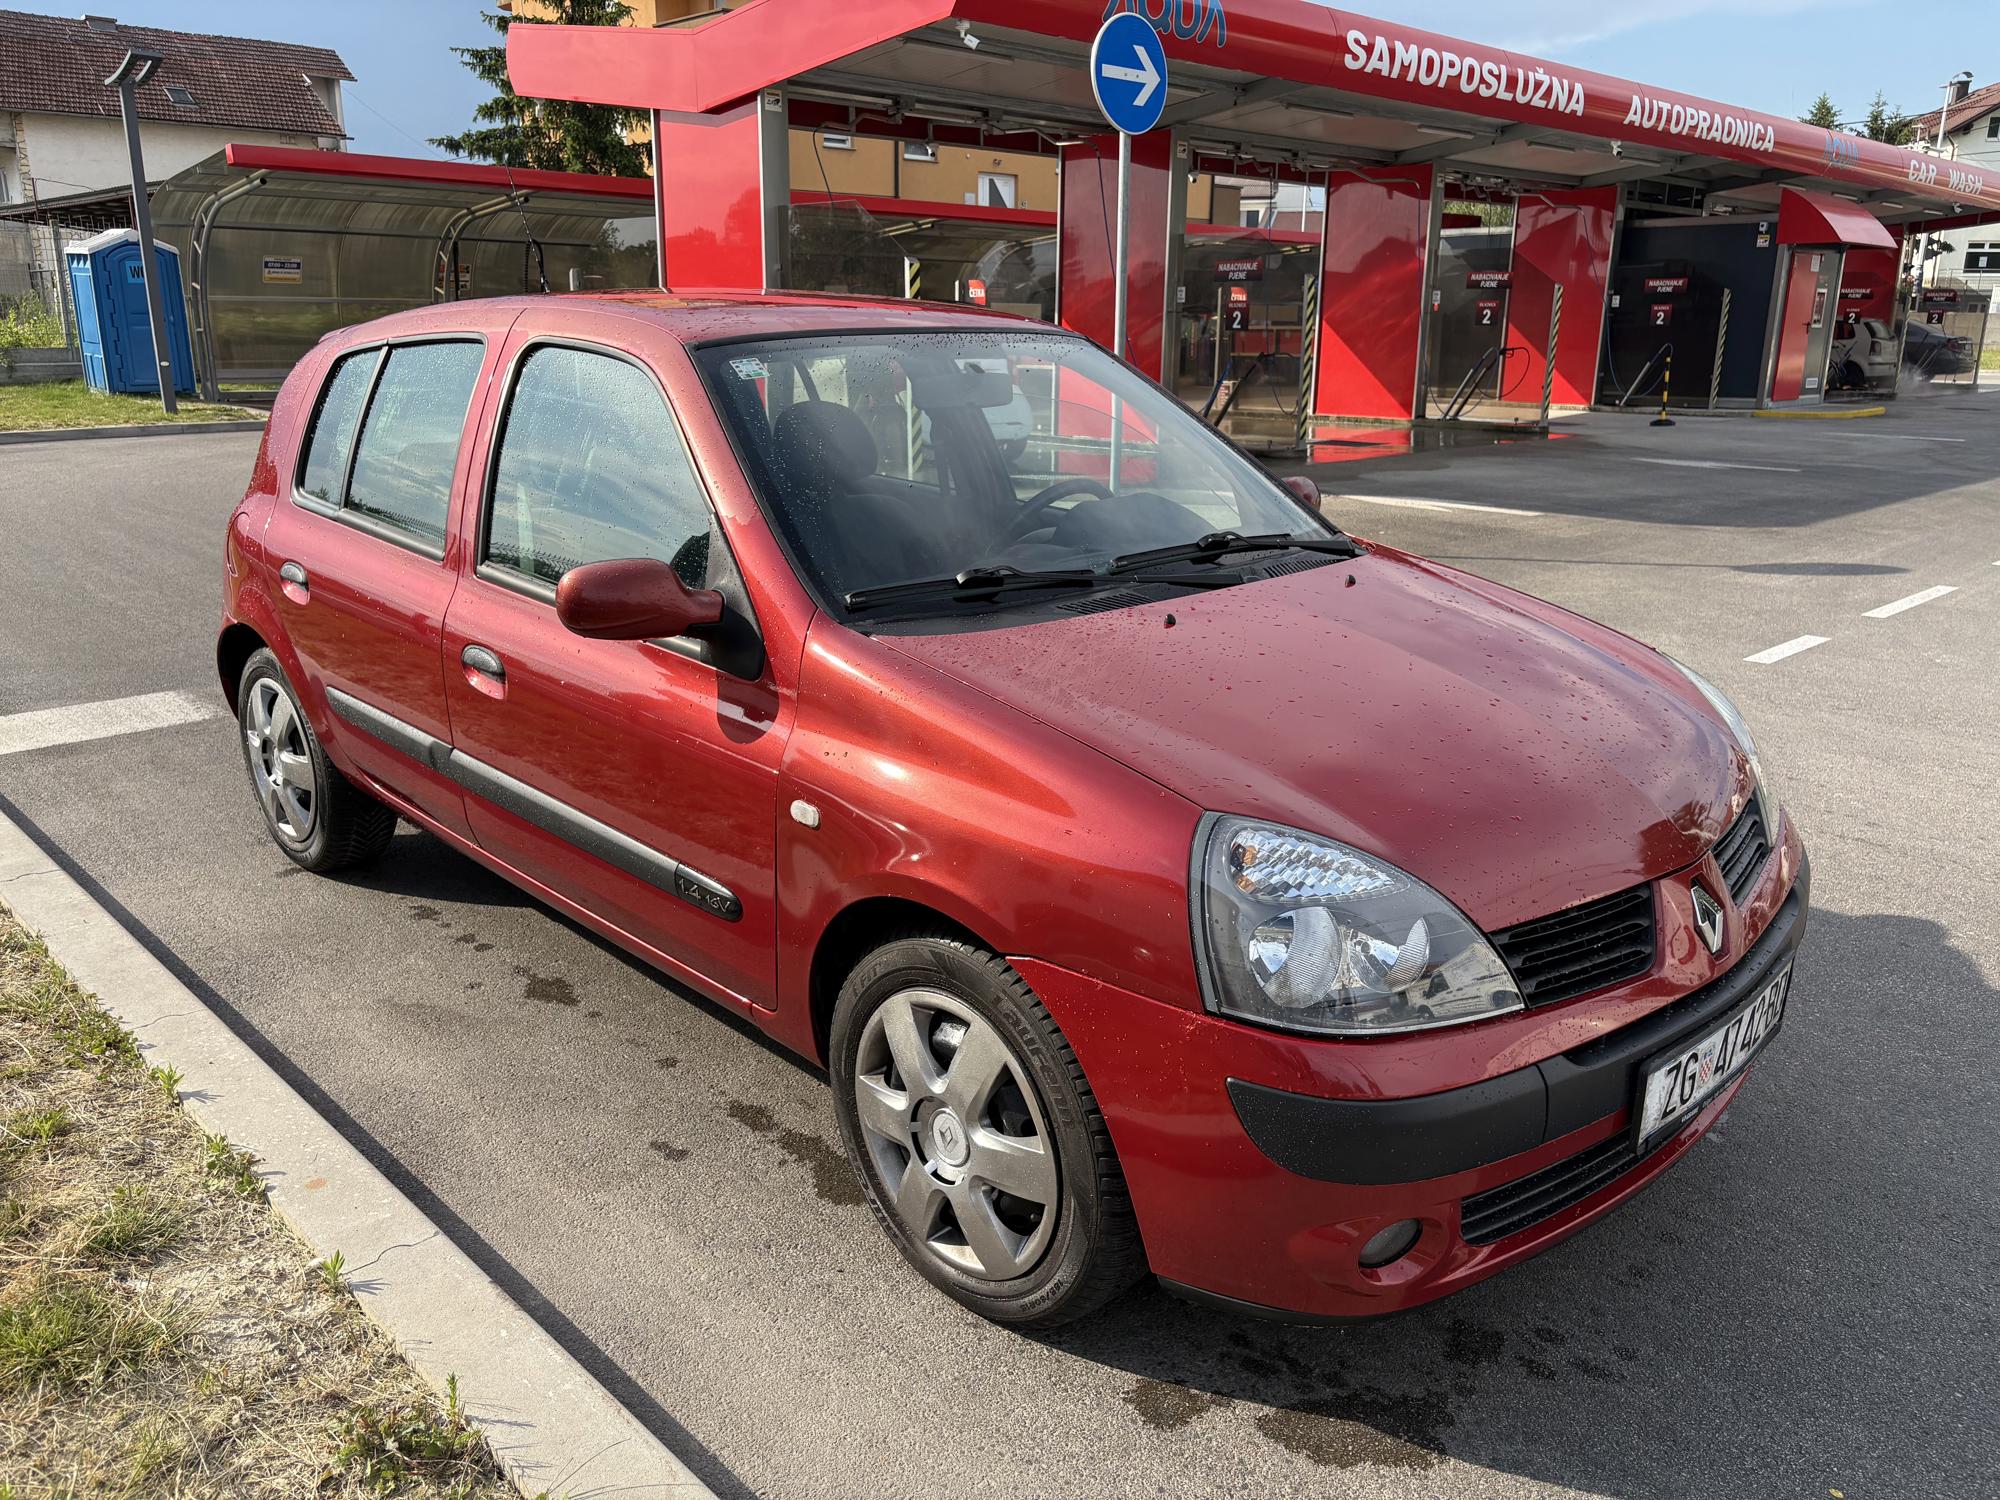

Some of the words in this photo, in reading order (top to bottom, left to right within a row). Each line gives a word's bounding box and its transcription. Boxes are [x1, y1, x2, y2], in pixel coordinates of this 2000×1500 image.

[1344, 29, 1585, 117] SAMOPOSLUŽNA
[1623, 95, 1775, 153] AUTOPRAONICA
[1908, 159, 1937, 185] CAR
[1949, 168, 1983, 195] WASH
[1218, 262, 1258, 272] NABACIVANJE
[1228, 271, 1247, 280] PJENE
[1471, 273, 1509, 281] NABACIVANJE
[1480, 280, 1498, 288] PJENE
[1648, 279, 1684, 287] NABACIVANJE
[1232, 310, 1241, 328] 2
[1482, 309, 1491, 324] 2
[1656, 311, 1664, 325] 2
[1847, 312, 1856, 324] 2
[1931, 313, 1939, 323] 2
[678, 878, 702, 902] 1.4
[1660, 1052, 1699, 1121] ZG
